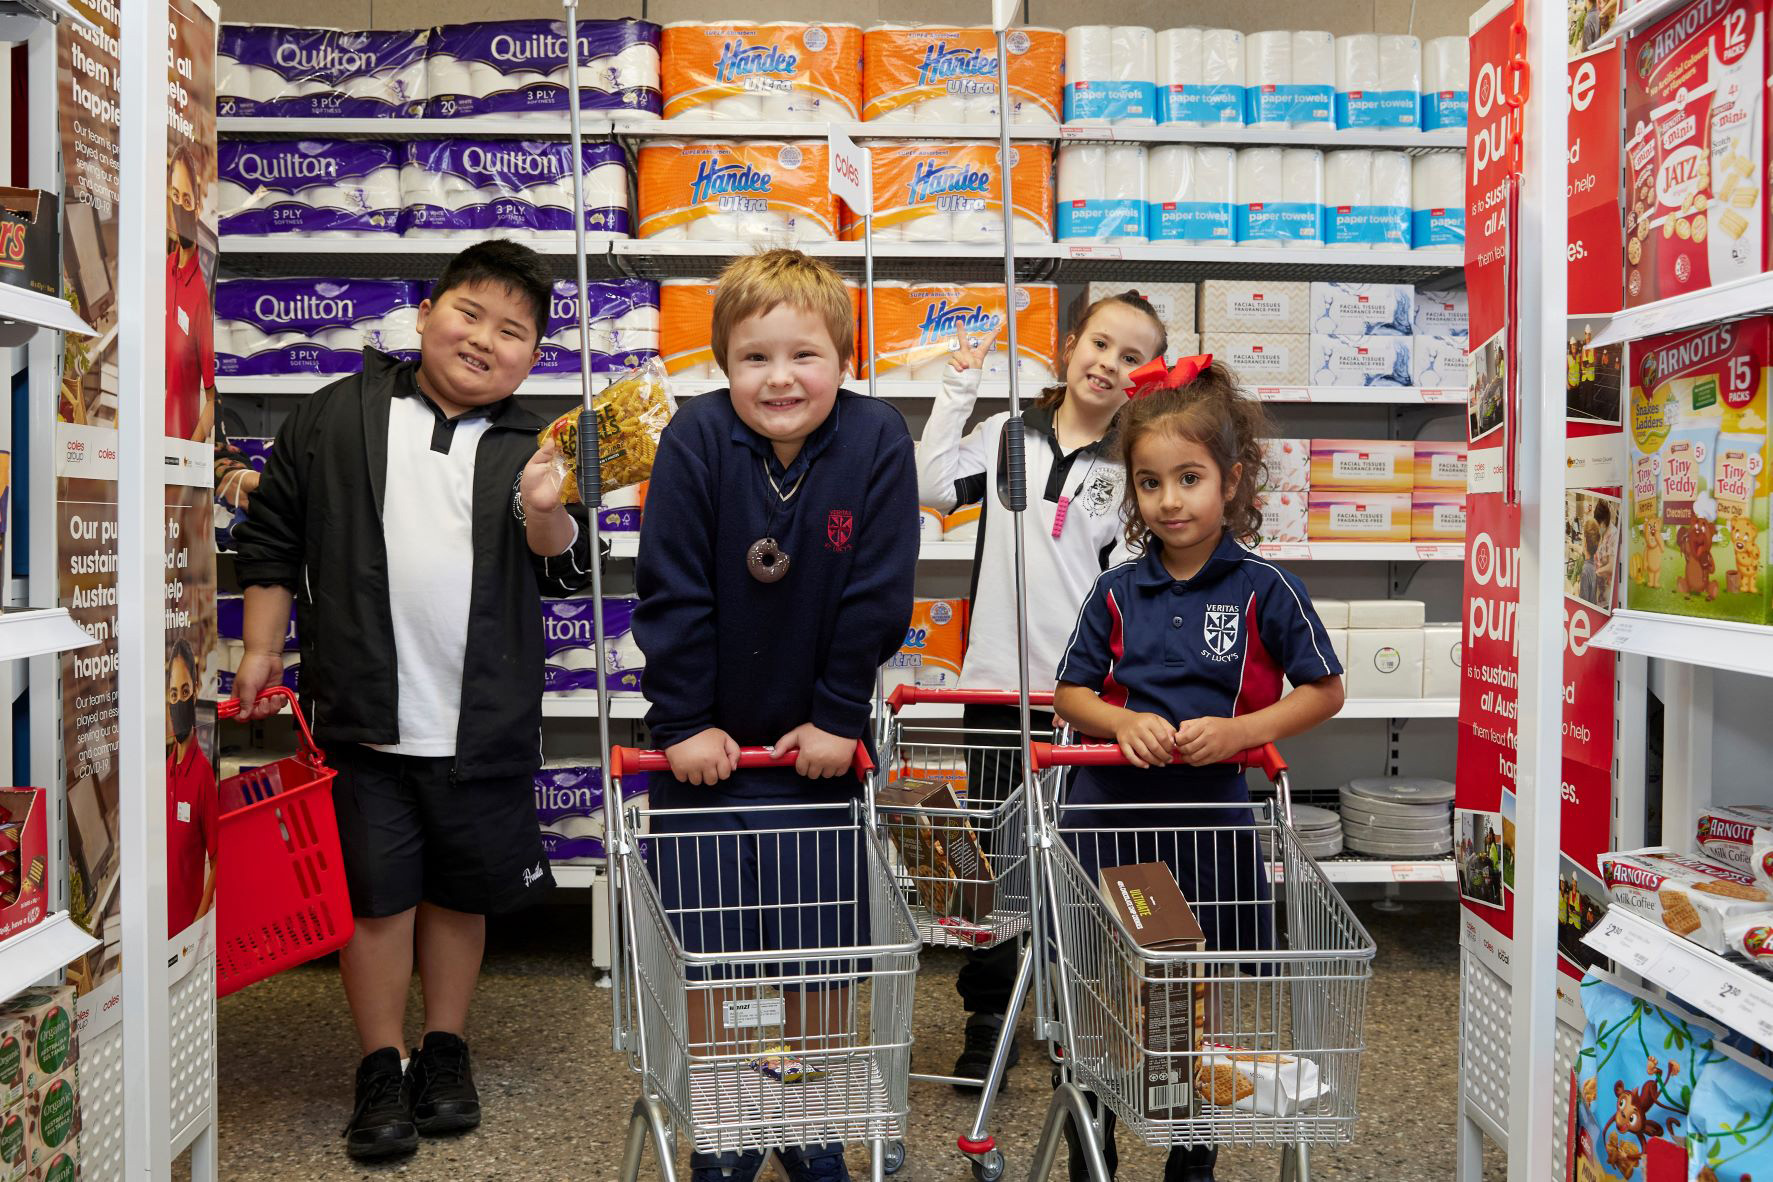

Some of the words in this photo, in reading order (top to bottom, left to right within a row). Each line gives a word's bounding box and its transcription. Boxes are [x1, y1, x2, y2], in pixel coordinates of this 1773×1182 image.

[1723, 8, 1746, 48] 12
[276, 43, 376, 70] Quilton
[491, 34, 589, 62] Quilton
[1723, 43, 1746, 61] PACKS
[72, 42, 109, 86] them
[177, 58, 192, 80] all
[713, 39, 798, 83] Handee
[916, 41, 999, 87] Handee
[168, 81, 188, 109] elp
[527, 91, 534, 100] 3
[537, 90, 556, 100] PLY
[945, 78, 995, 95] Ultra
[1075, 91, 1106, 101] paper
[1108, 89, 1143, 100] towels
[312, 99, 318, 107] 3
[321, 99, 341, 108] PLY
[441, 101, 455, 112] 20
[1169, 94, 1200, 104] paper
[1202, 93, 1236, 104] towels
[1261, 94, 1292, 105] paper
[1294, 92, 1328, 103] towels
[1348, 100, 1378, 111] paper
[1381, 98, 1413, 109] towels
[74, 121, 87, 137] Our
[88, 128, 106, 147] team
[75, 140, 98, 161] played
[100, 153, 109, 166] an
[463, 147, 557, 174] Quilton
[76, 158, 101, 180] serving
[101, 169, 113, 183] our
[239, 153, 337, 181] Quilton
[835, 153, 859, 187] coles
[1663, 156, 1697, 193] JATZ
[78, 175, 93, 190] and
[690, 157, 772, 205] Handee
[906, 159, 990, 205] Handee
[1574, 174, 1596, 195] help
[504, 205, 525, 215] PLY
[718, 195, 768, 213] Ultra
[936, 195, 986, 212] Ultra
[1072, 208, 1103, 219] paper
[1105, 207, 1138, 218] towels
[1471, 203, 1477, 216] is
[1478, 199, 1485, 213] to
[274, 211, 280, 219] 3
[283, 210, 302, 219] PLY
[788, 218, 796, 227] 4
[1162, 211, 1193, 222] paper
[1195, 211, 1229, 221] towels
[1249, 212, 1280, 223] paper
[1282, 211, 1315, 221] towels
[1337, 215, 1367, 225] paper
[1369, 214, 1401, 224] towels
[1430, 217, 1462, 228] paper
[1484, 212, 1497, 237] all
[1477, 248, 1495, 268] them
[255, 294, 353, 322] Quilton
[918, 300, 999, 346] Handee
[290, 351, 296, 360] 3
[299, 351, 319, 360] PLY
[1658, 324, 1732, 377] ARNOTT'S
[1728, 355, 1751, 391] 15
[1728, 391, 1750, 403] PACKS
[1636, 403, 1659, 416] Snakes
[1636, 416, 1663, 430] Ladders
[67, 440, 85, 452] coles
[98, 449, 116, 460] coles
[66, 451, 84, 463] group
[1637, 467, 1652, 482] Tiny
[1667, 458, 1691, 477] Tiny
[1723, 463, 1746, 482] Tiny
[1635, 480, 1655, 497] Teddy
[1663, 476, 1696, 498] Teddy
[1717, 478, 1749, 500] Teddy
[1665, 507, 1691, 519] Chocolate
[1717, 502, 1731, 513] Choc
[70, 515, 99, 540] Our
[169, 517, 180, 539] to
[177, 547, 188, 569] all
[1206, 604, 1239, 613] VERITAS
[1201, 649, 1212, 660] ST
[1212, 653, 1239, 663] LUCY'S
[939, 673, 945, 681] 3
[1467, 664, 1473, 678] is
[1474, 666, 1480, 680] to
[75, 696, 88, 709] Our
[89, 693, 106, 706] team
[1481, 692, 1494, 712] all
[76, 710, 98, 730] played
[100, 710, 108, 721] an
[77, 729, 99, 744] serving
[100, 725, 111, 736] our
[1473, 721, 1490, 742] them
[1491, 727, 1506, 747] lead
[1570, 723, 1591, 745] help
[78, 747, 93, 761] and
[1710, 847, 1727, 859] Milk
[1613, 864, 1662, 888] ARNOTT'S
[1129, 888, 1152, 917] ULTIMATE
[1615, 892, 1631, 906] Milk
[1631, 895, 1656, 910] Coffee
[103, 994, 120, 1013] coles
[40, 1019, 67, 1043] Organic
[43, 1092, 71, 1117] Organic
